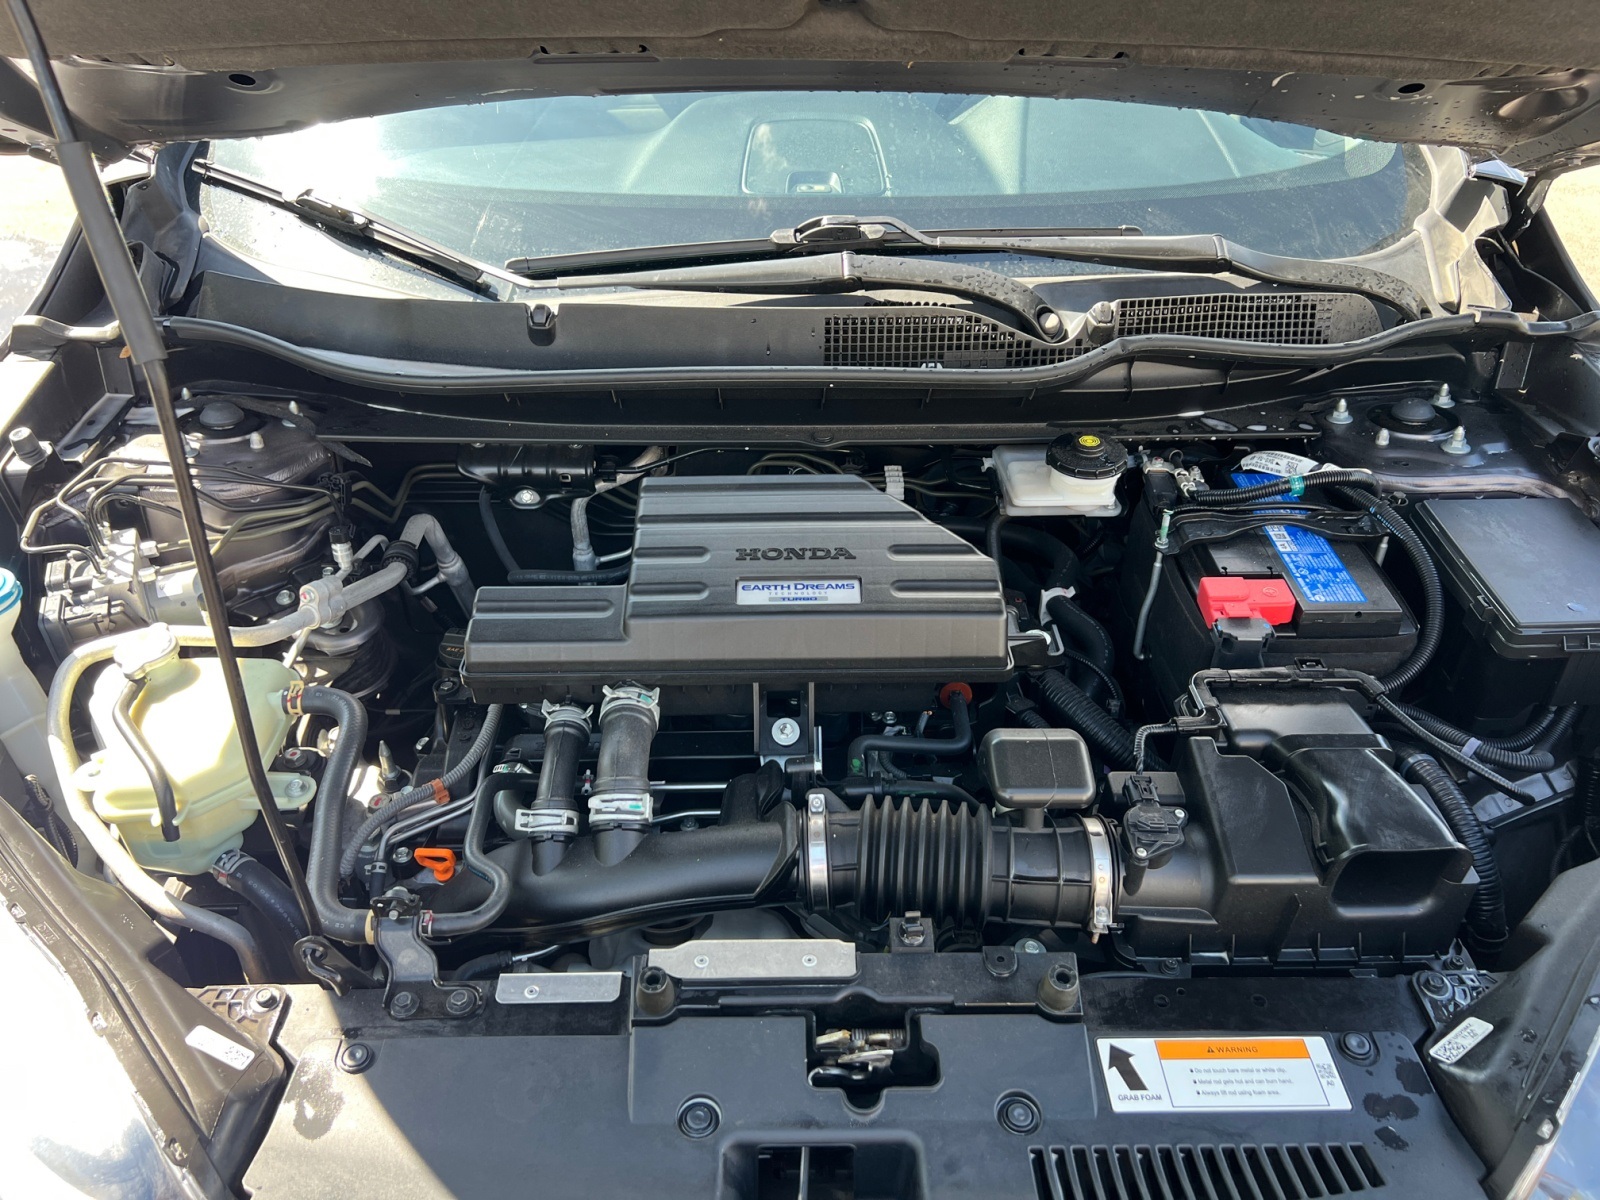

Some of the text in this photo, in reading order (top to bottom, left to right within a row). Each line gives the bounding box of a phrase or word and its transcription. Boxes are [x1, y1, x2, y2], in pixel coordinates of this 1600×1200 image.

[735, 547, 856, 560] HONDA
[741, 582, 855, 591] EARTH DREAMS
